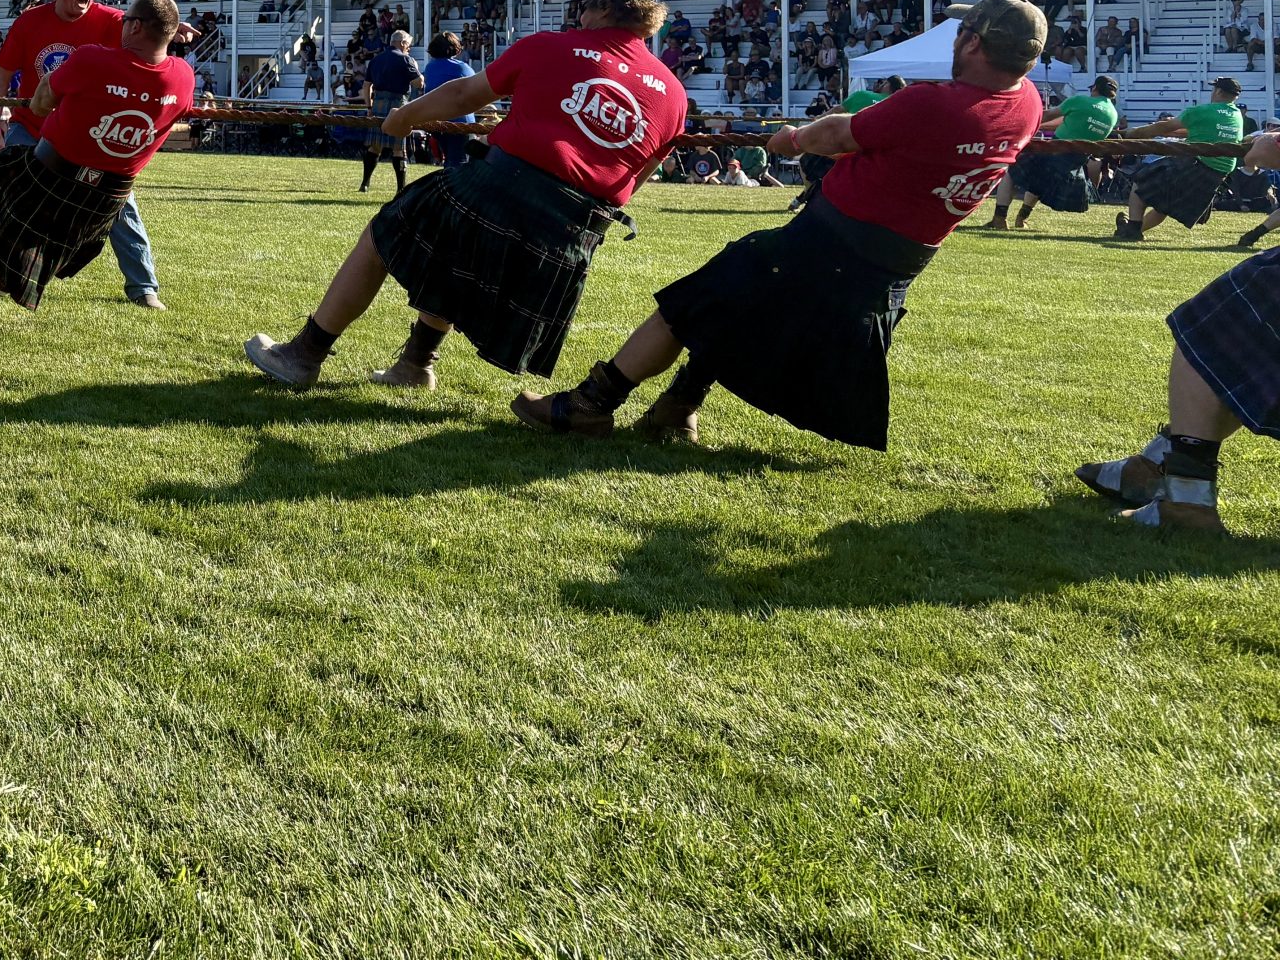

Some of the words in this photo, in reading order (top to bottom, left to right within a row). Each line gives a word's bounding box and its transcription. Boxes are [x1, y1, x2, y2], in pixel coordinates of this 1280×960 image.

[572, 48, 602, 62] TUG
[618, 62, 629, 74] O
[642, 74, 667, 95] WAR
[105, 84, 128, 98] TUG
[140, 92, 150, 102] O
[956, 143, 986, 155] TUG
[998, 140, 1009, 152] O
